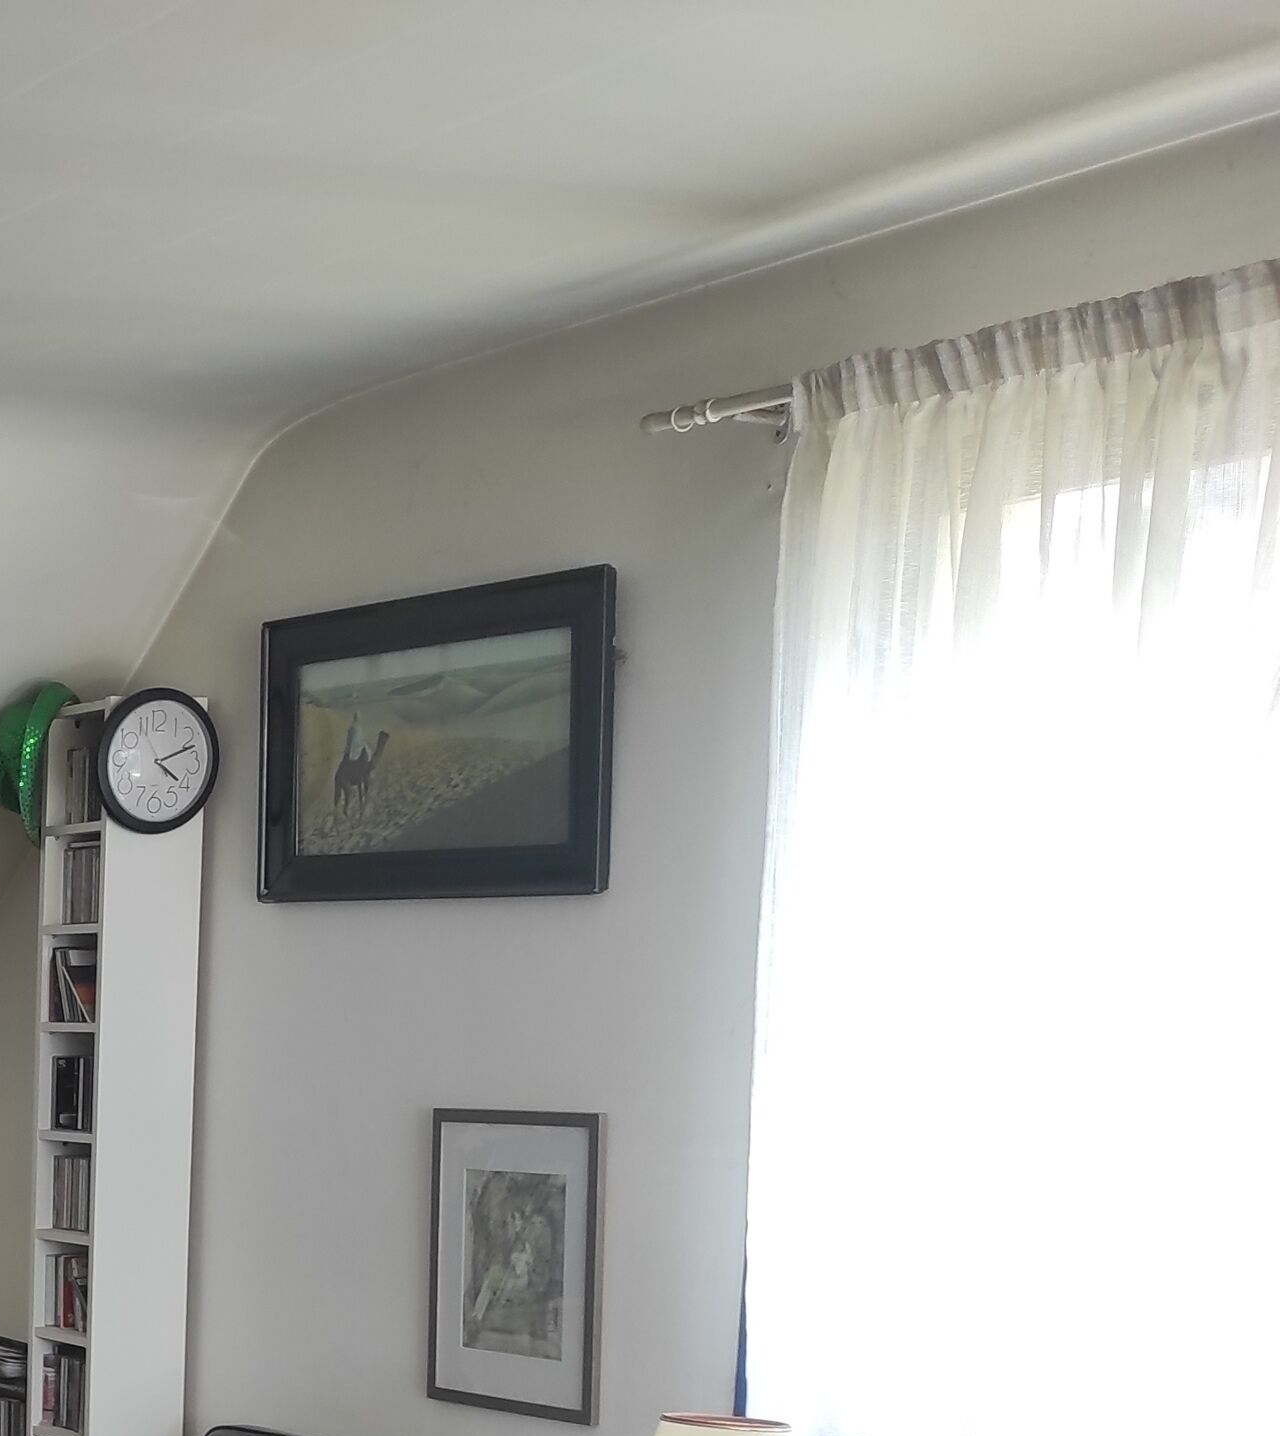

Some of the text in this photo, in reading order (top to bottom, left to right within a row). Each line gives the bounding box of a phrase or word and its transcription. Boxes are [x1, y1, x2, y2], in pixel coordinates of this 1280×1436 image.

[139, 716, 149, 737] 11
[152, 709, 167, 732] 12
[120, 727, 139, 750] 10
[182, 726, 195, 750] 2
[112, 749, 128, 773] 9
[186, 750, 200, 775] 3
[117, 771, 133, 795] 8
[178, 772, 190, 793] 4
[136, 785, 146, 808] 7
[146, 790, 162, 814] 6
[163, 785, 178, 808] 5
